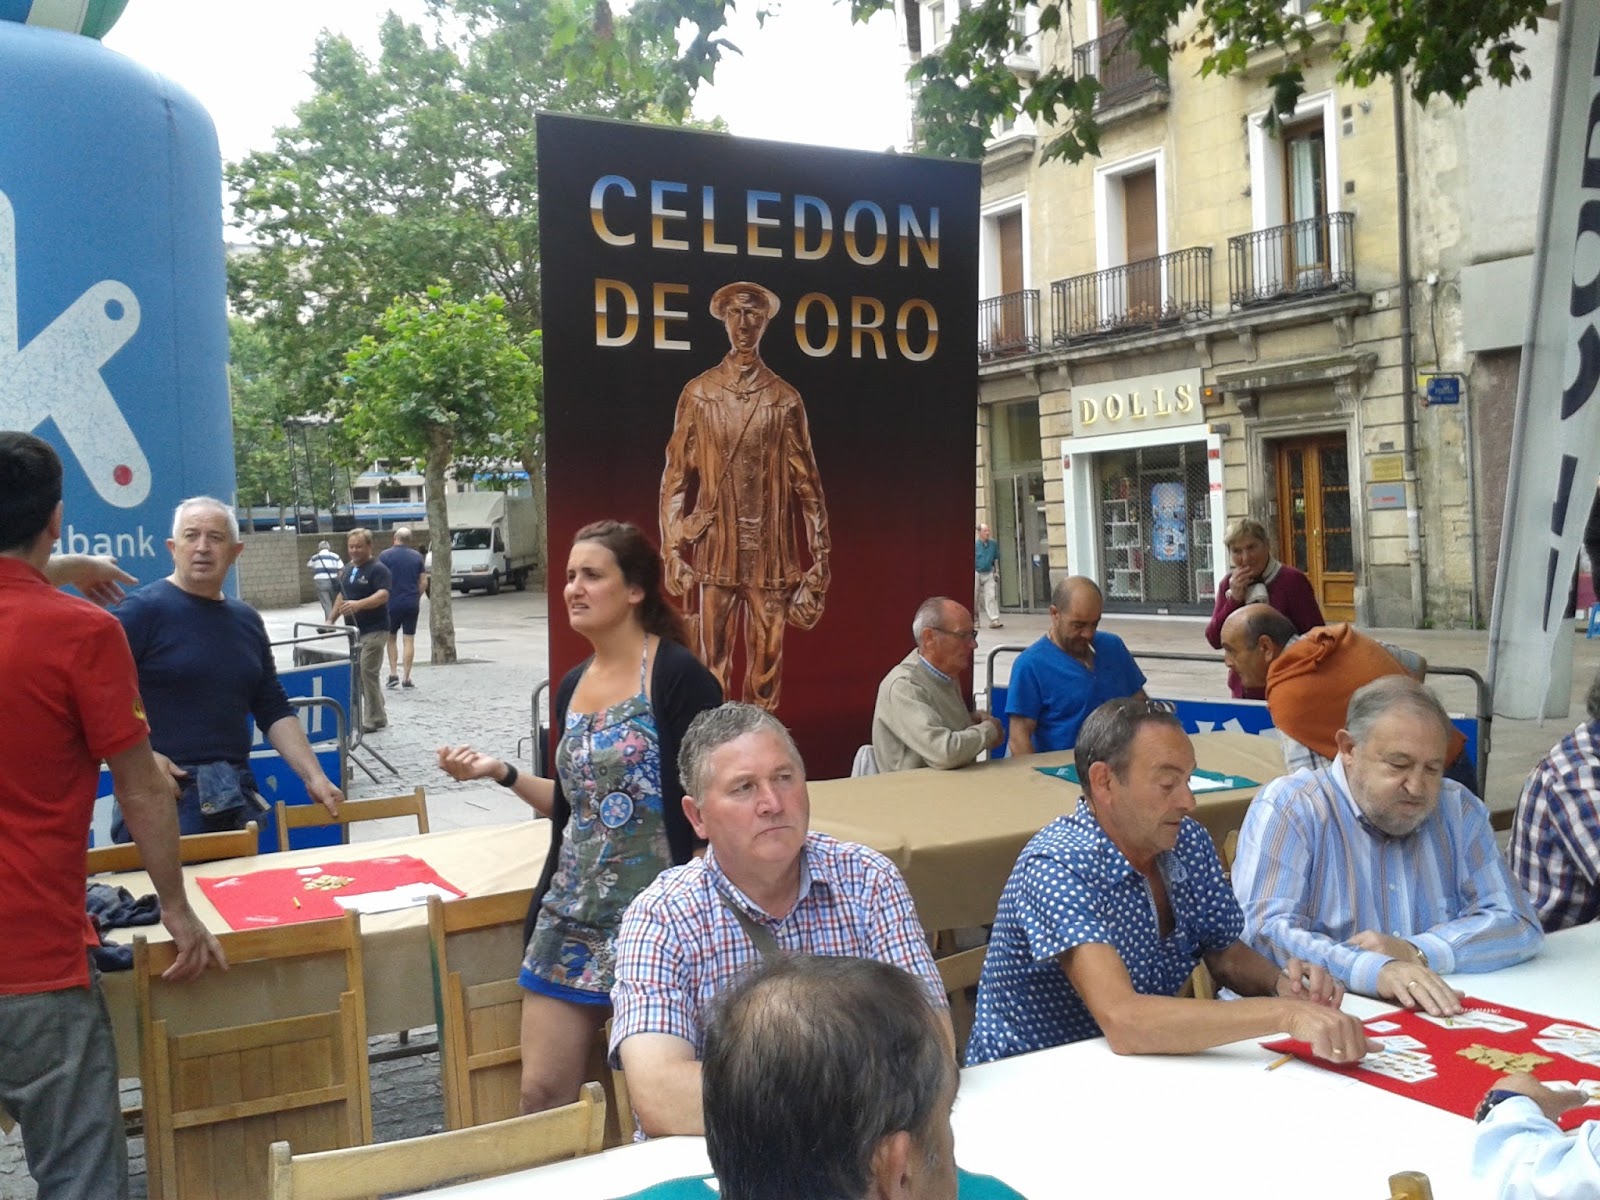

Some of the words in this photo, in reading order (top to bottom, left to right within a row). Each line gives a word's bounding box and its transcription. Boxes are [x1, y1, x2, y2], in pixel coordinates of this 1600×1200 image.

[589, 174, 940, 270] CELEDON
[594, 277, 692, 351] DE
[794, 292, 939, 362] ORO
[1079, 383, 1195, 425] DOLLS
